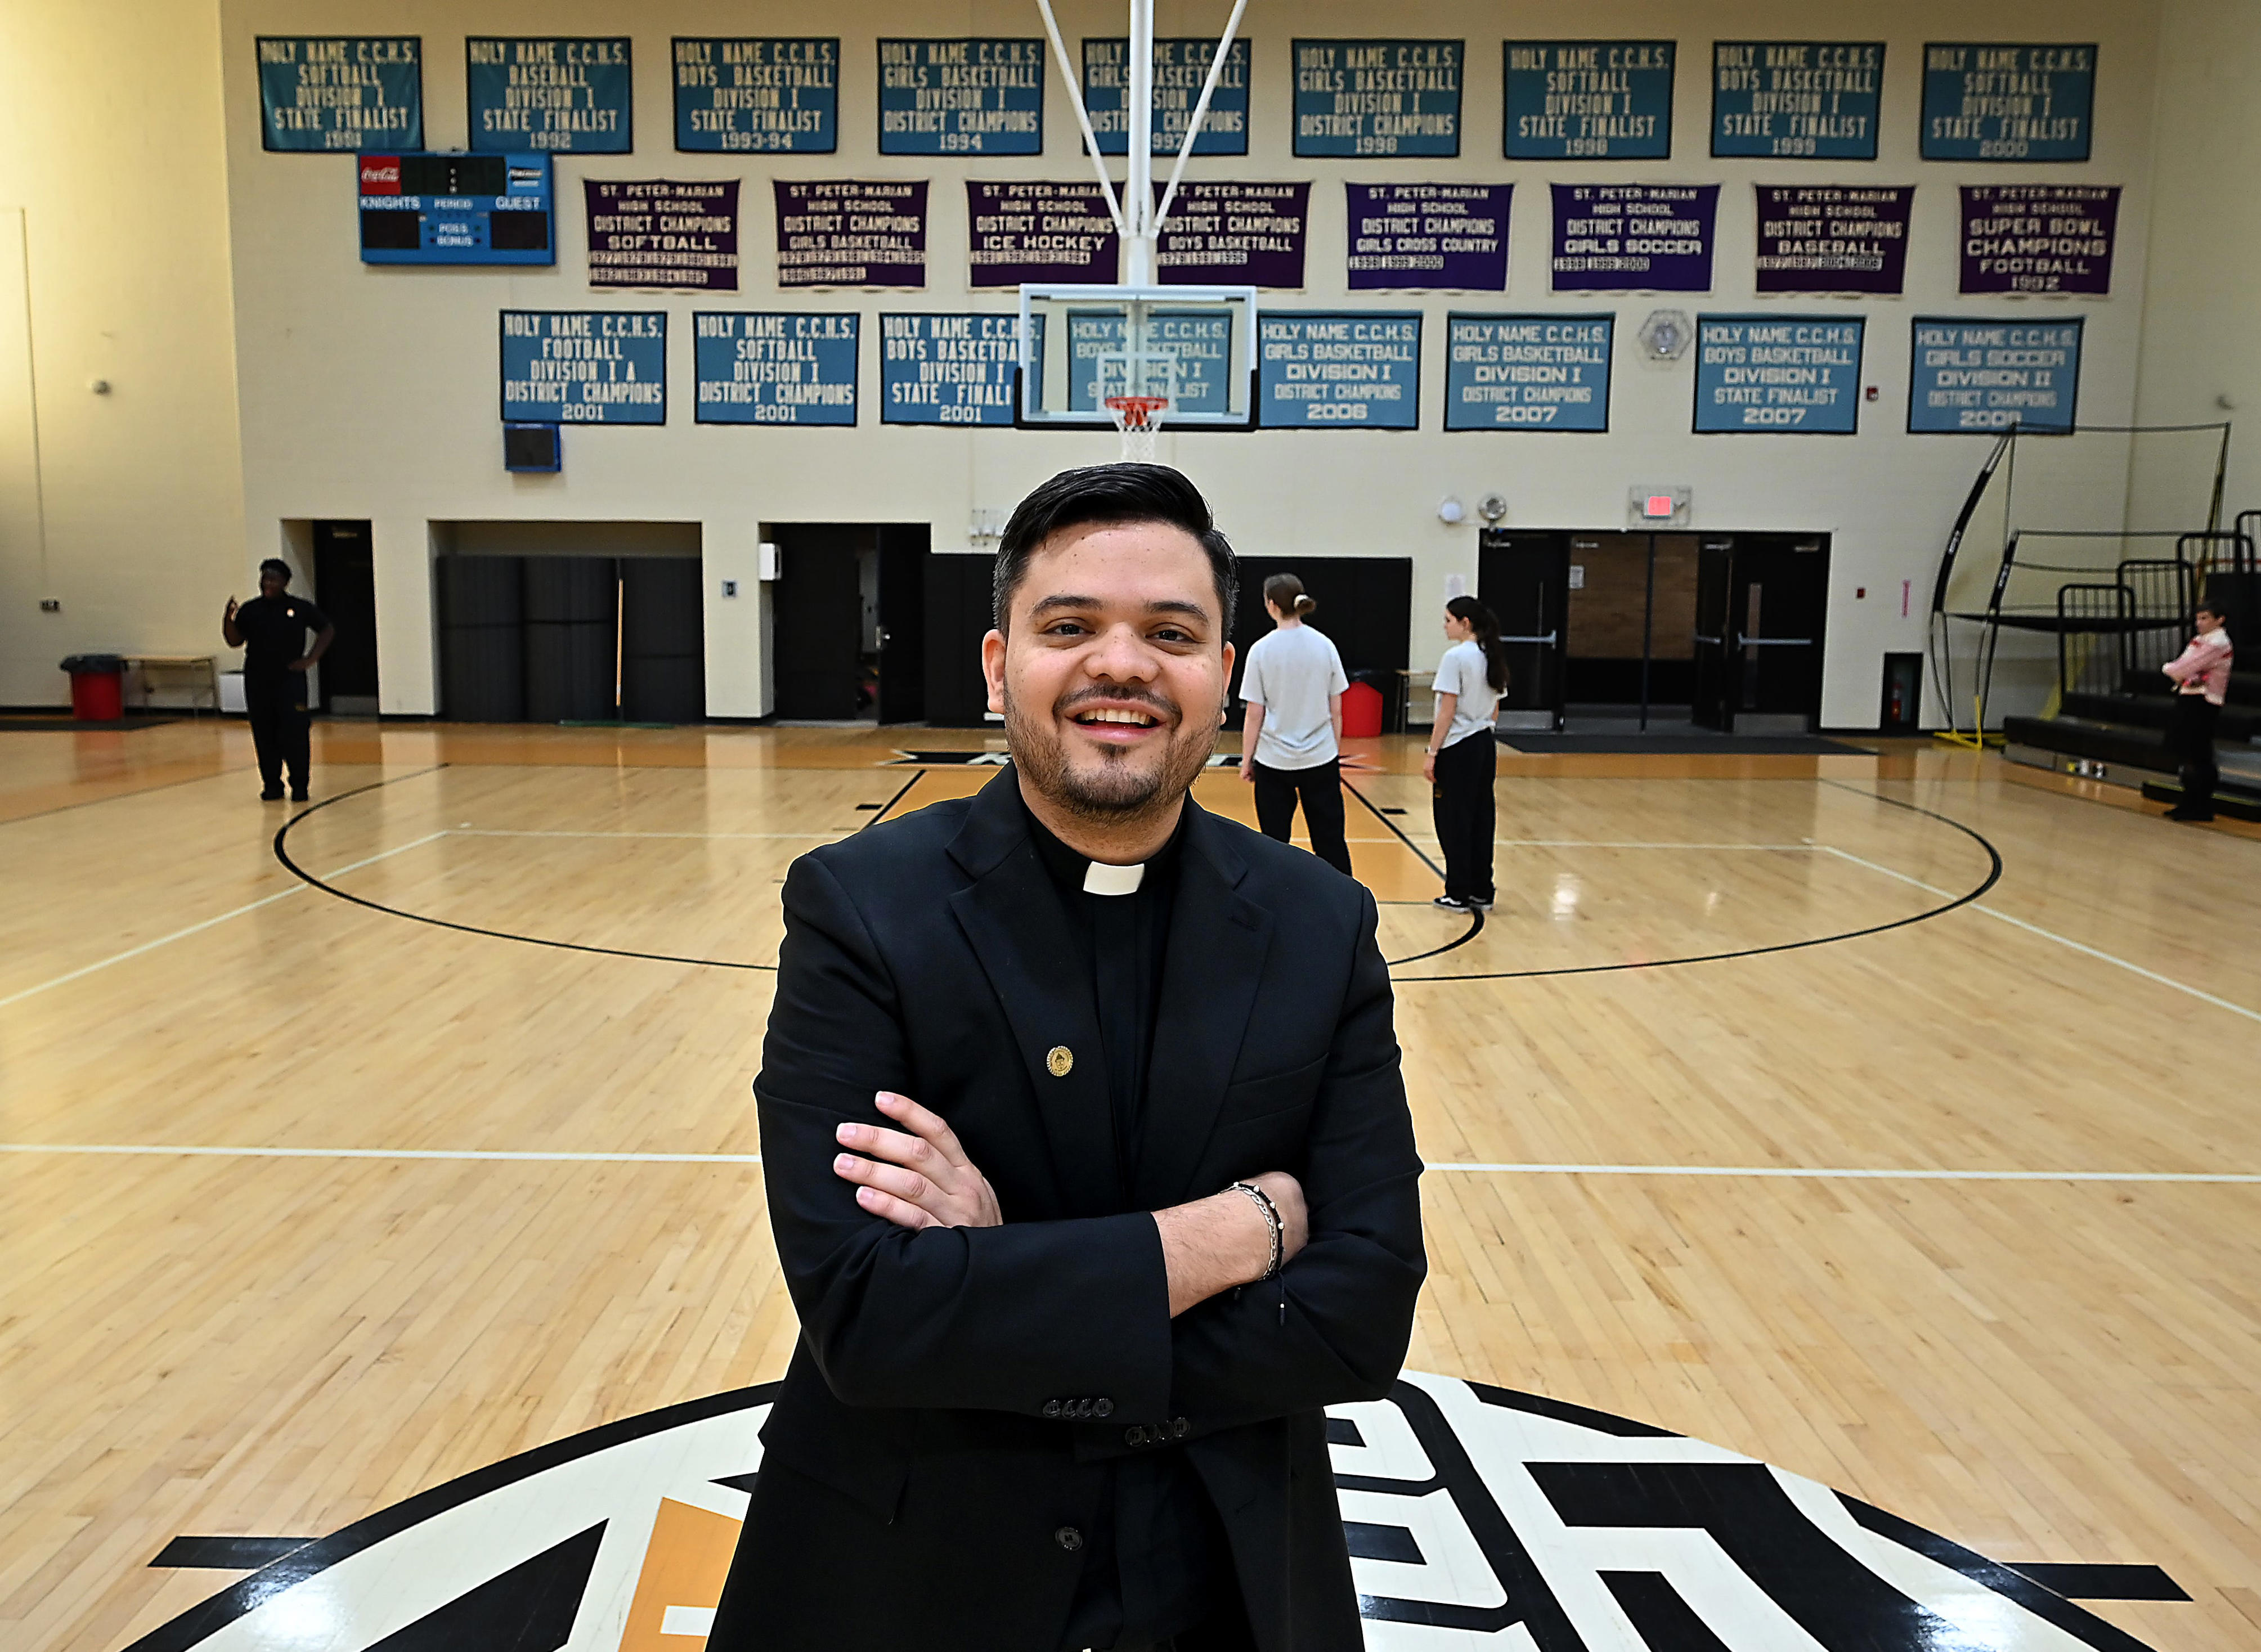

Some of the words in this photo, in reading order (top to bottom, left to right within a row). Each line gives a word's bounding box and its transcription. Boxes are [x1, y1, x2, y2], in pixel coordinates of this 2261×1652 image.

[483, 107, 531, 131] STATE
[544, 109, 617, 131] FINALIST
[691, 109, 735, 131] STATE
[752, 110, 821, 132] FINALIST
[1519, 115, 1566, 138] STATE
[1581, 115, 1655, 137] FINALIST
[1724, 114, 1771, 136] STATE
[1790, 115, 1866, 137] FINALIST
[360, 196, 421, 210] KNIGHTS
[495, 196, 540, 210] GUEST
[1970, 218, 2041, 235] SUPER
[2049, 218, 2103, 236] BOWL
[983, 235, 1015, 252] ICE
[1023, 235, 1105, 252] HOCKEY
[1980, 258, 2089, 273] FOOTBALL
[504, 315, 540, 336] HOLY
[551, 315, 592, 337] NAME
[698, 316, 734, 338] HOLY
[744, 316, 786, 338] NAME
[883, 317, 921, 338] HOLY
[931, 317, 972, 339] NAME
[1262, 324, 1301, 340] HOLY
[1306, 324, 1349, 340] NAME
[1452, 325, 1493, 342] HOLY
[1497, 325, 1541, 342] NAME
[1702, 326, 1743, 344] HOLY
[1748, 327, 1792, 344] NAME
[542, 338, 623, 360] FOOTBALL
[737, 339, 817, 361] SOFTBALL
[887, 339, 927, 360] BOYS
[1264, 343, 1309, 360] GIRLS
[1313, 344, 1413, 361] BASKETBALL
[1452, 345, 1499, 362] GIRLS
[1502, 346, 1604, 363] BASKETBALL
[1704, 347, 1746, 364] BOYS
[1751, 347, 1852, 365] BASKETBALL
[531, 360, 598, 382] DIVISION
[734, 361, 801, 383] DIVISION
[919, 362, 986, 383] DIVISION
[1286, 363, 1378, 380] DIVISION
[1475, 366, 1567, 382] DIVISION
[1724, 367, 1817, 384] DIVISION
[505, 379, 568, 402] DISTRICT
[582, 382, 662, 403] CHAMPIONS
[699, 381, 761, 402] DISTRICT
[775, 383, 854, 405] CHAMPIONS
[892, 382, 940, 404] STATE
[1275, 383, 1329, 399] DISTRICT
[1335, 384, 1401, 400] CHAMPIONS
[1463, 386, 1518, 402] DISTRICT
[1523, 387, 1591, 403] CHAMPIONS
[1714, 387, 1763, 404] STATE
[1767, 388, 1837, 405] FINALIST
[562, 403, 604, 420] 2001
[755, 404, 796, 421] 2001
[940, 405, 982, 423] 2001
[1496, 406, 1558, 422] 2007
[1743, 407, 1806, 424] 2007
